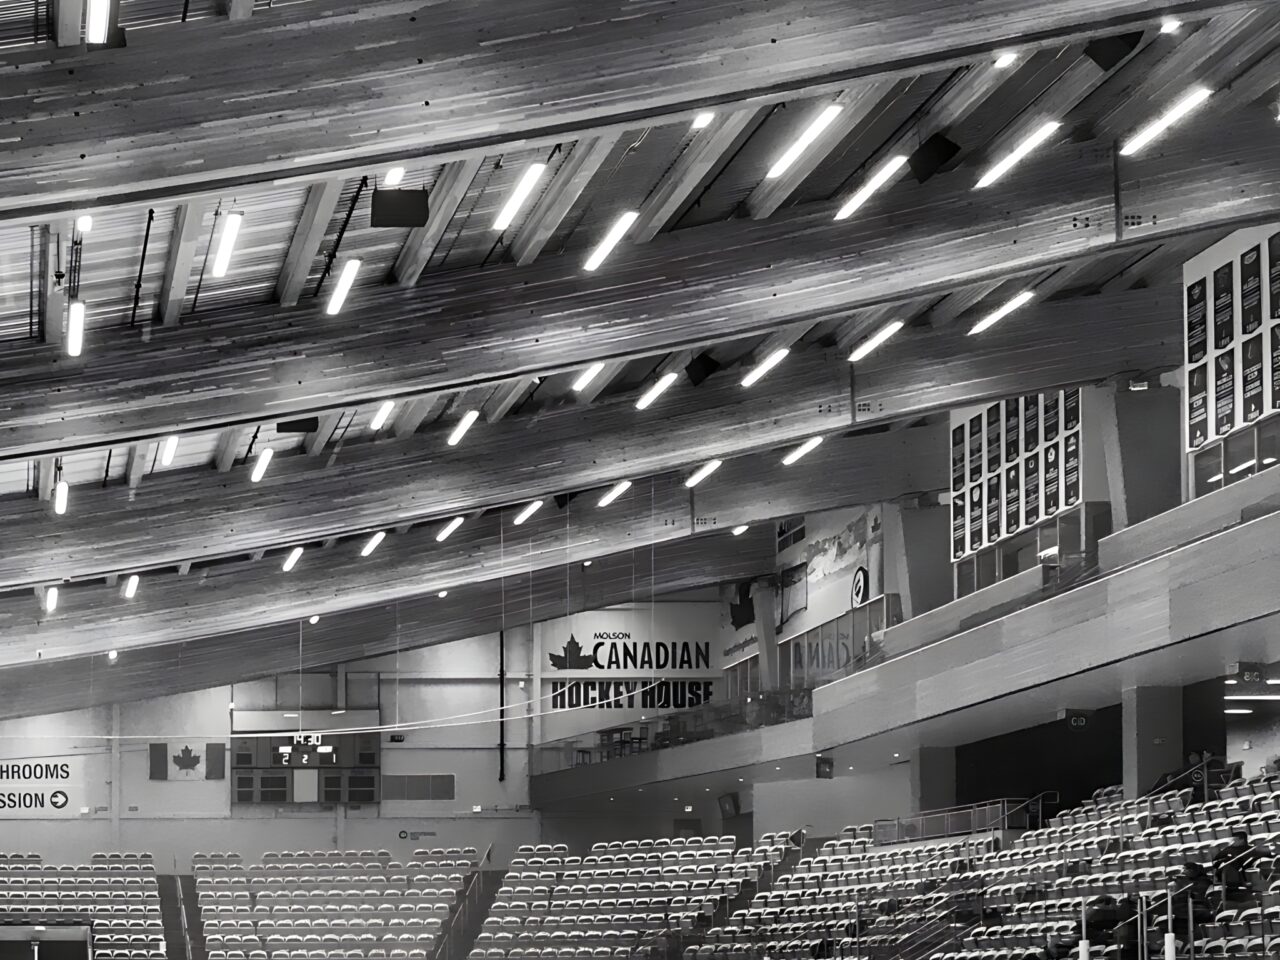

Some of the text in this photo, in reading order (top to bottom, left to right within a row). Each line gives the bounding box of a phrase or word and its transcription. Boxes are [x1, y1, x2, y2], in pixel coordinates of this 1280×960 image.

[593, 632, 631, 640] MOLSON
[592, 641, 710, 669] CANADIAN
[552, 681, 713, 709] HOCKEY HOUSE
